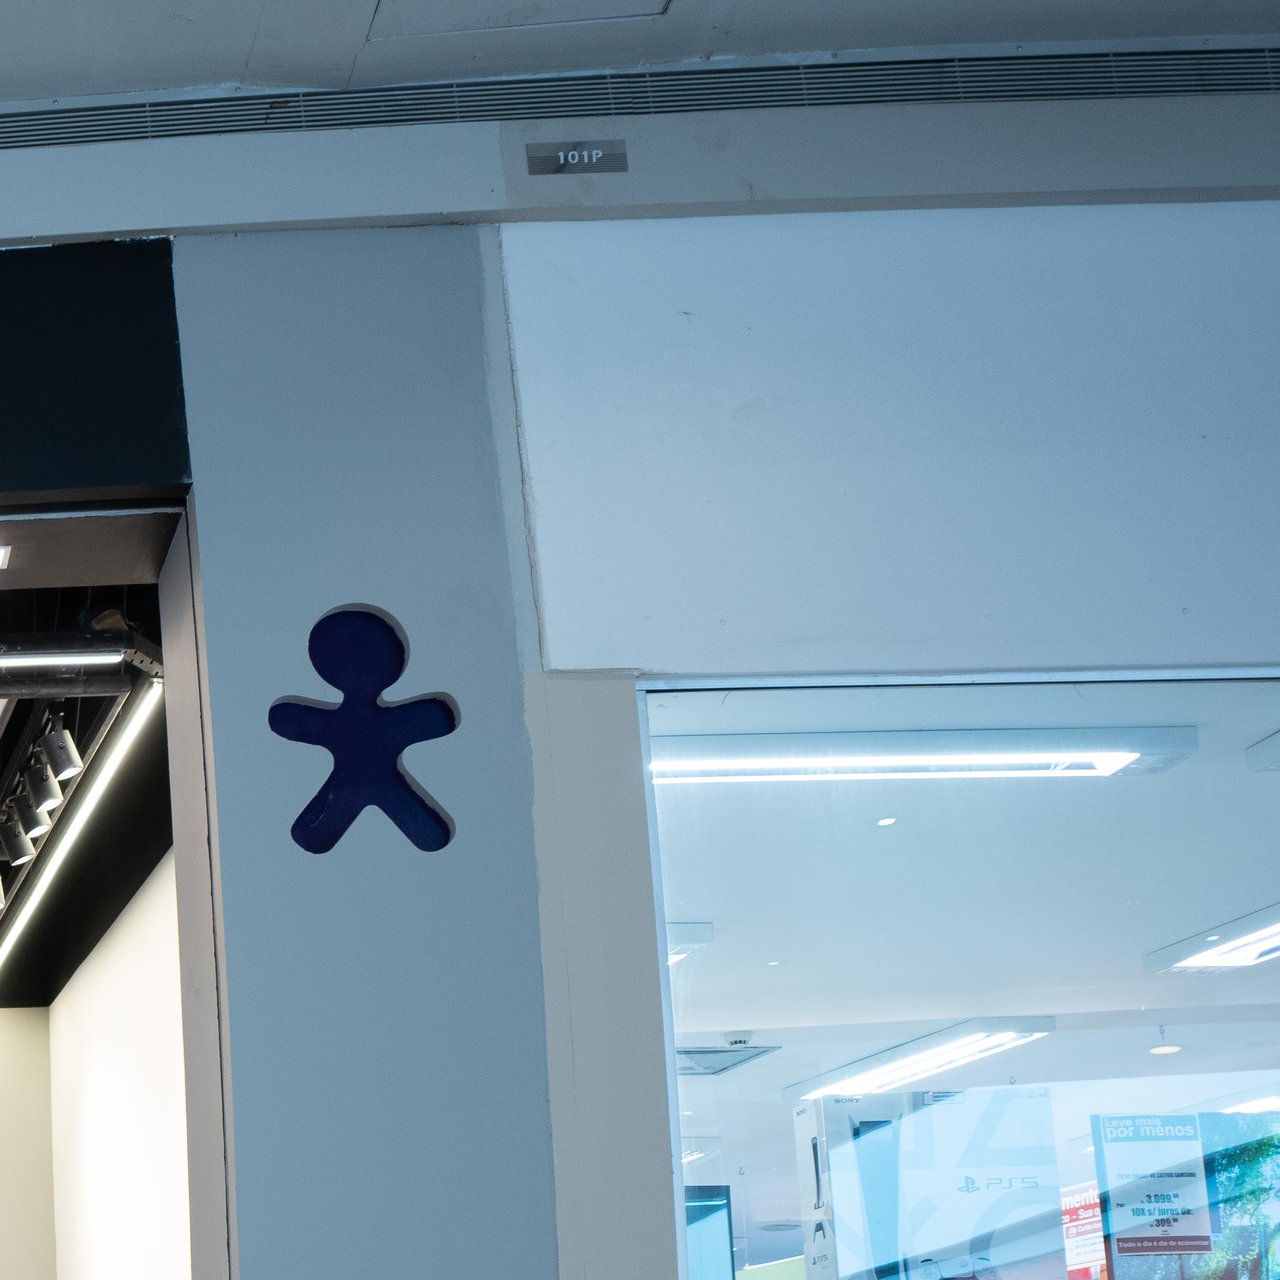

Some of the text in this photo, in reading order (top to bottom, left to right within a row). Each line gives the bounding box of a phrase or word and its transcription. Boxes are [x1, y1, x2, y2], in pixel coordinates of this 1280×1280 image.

[558, 150, 603, 164] 101P
[1106, 1124, 1194, 1140] por menos
[985, 1176, 1039, 1190] PS5
